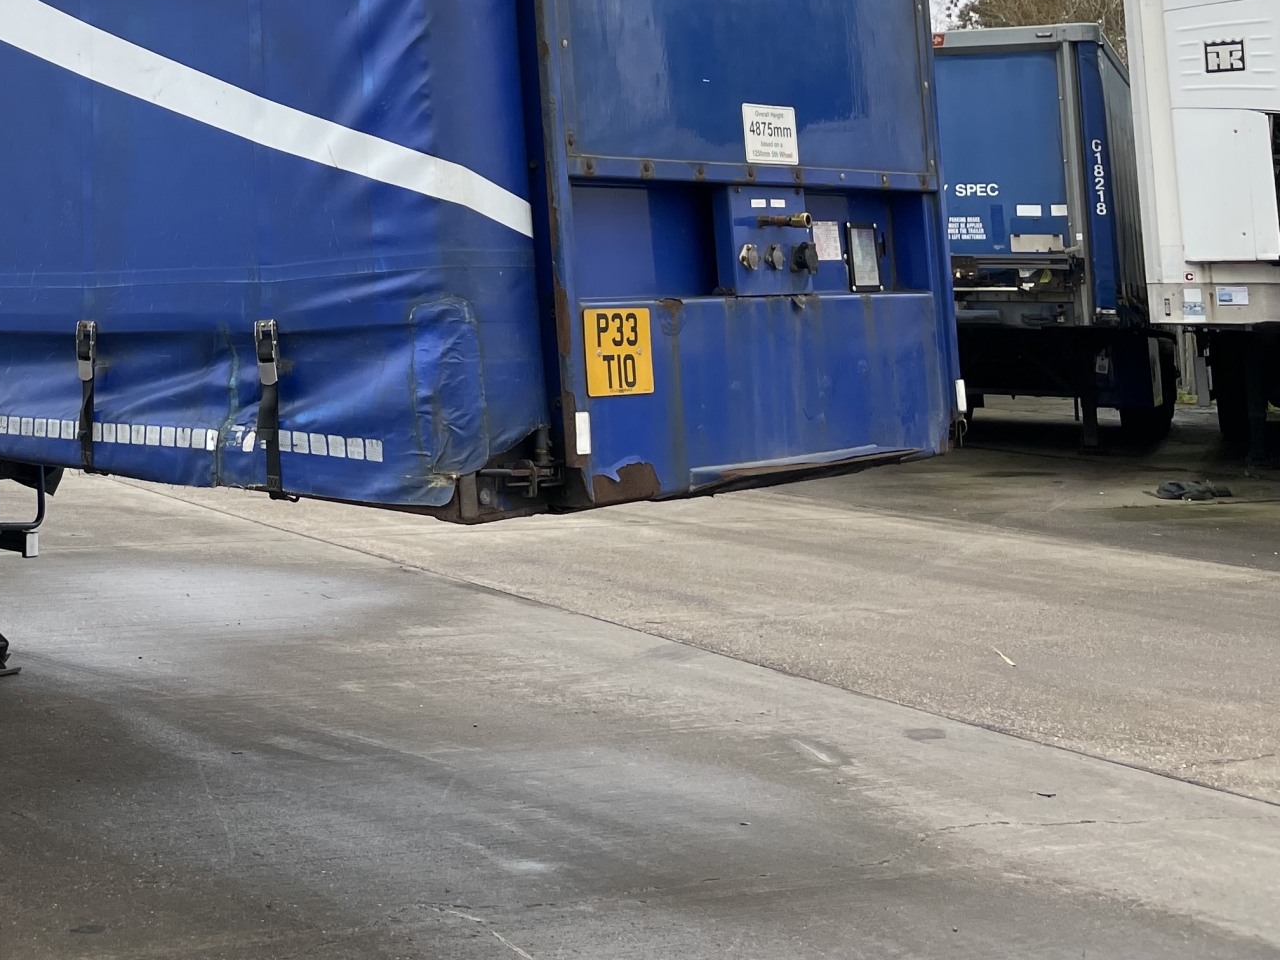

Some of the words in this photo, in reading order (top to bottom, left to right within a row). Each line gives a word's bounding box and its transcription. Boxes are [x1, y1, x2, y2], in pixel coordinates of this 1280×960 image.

[754, 110, 770, 118] Overall
[749, 120, 792, 139] 4875mm
[771, 150, 779, 158] 5th
[779, 151, 793, 159] Wheel
[1091, 139, 1107, 215] G18218
[955, 183, 999, 197] SPEC
[1185, 272, 1194, 281] C
[596, 312, 638, 347] P33
